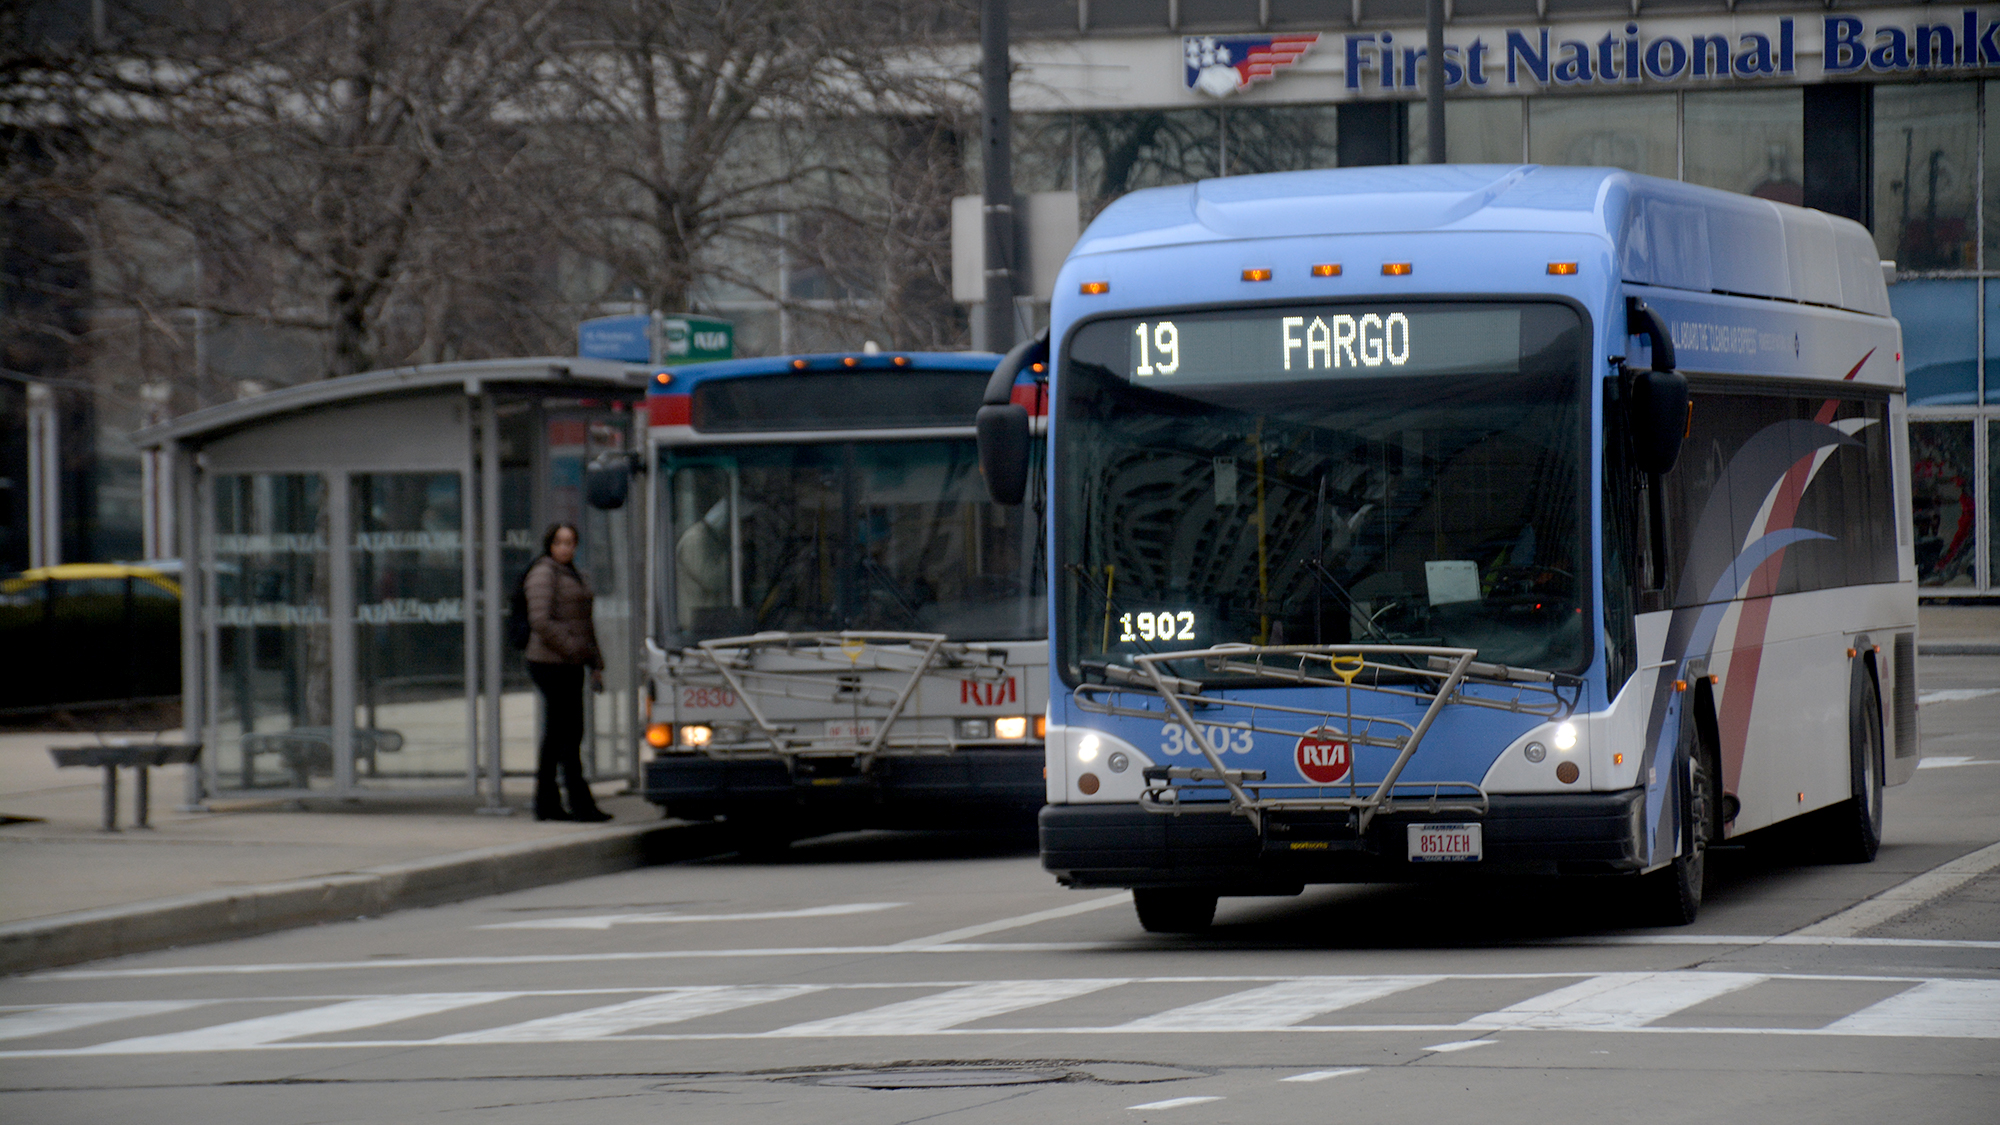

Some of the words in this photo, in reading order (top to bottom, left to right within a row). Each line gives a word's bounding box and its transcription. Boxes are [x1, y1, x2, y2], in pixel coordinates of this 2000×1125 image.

[1343, 30, 1490, 92] First
[1504, 18, 1797, 86] National
[1822, 9, 2000, 73] Bank
[1136, 321, 1180, 376] 19
[1283, 312, 1411, 371] FARGO
[1119, 611, 1196, 642] 1902
[683, 687, 735, 708] 2830
[1161, 721, 1254, 756] 3603
[1303, 744, 1346, 767] RTA
[1421, 834, 1470, 853] 851ZEH
